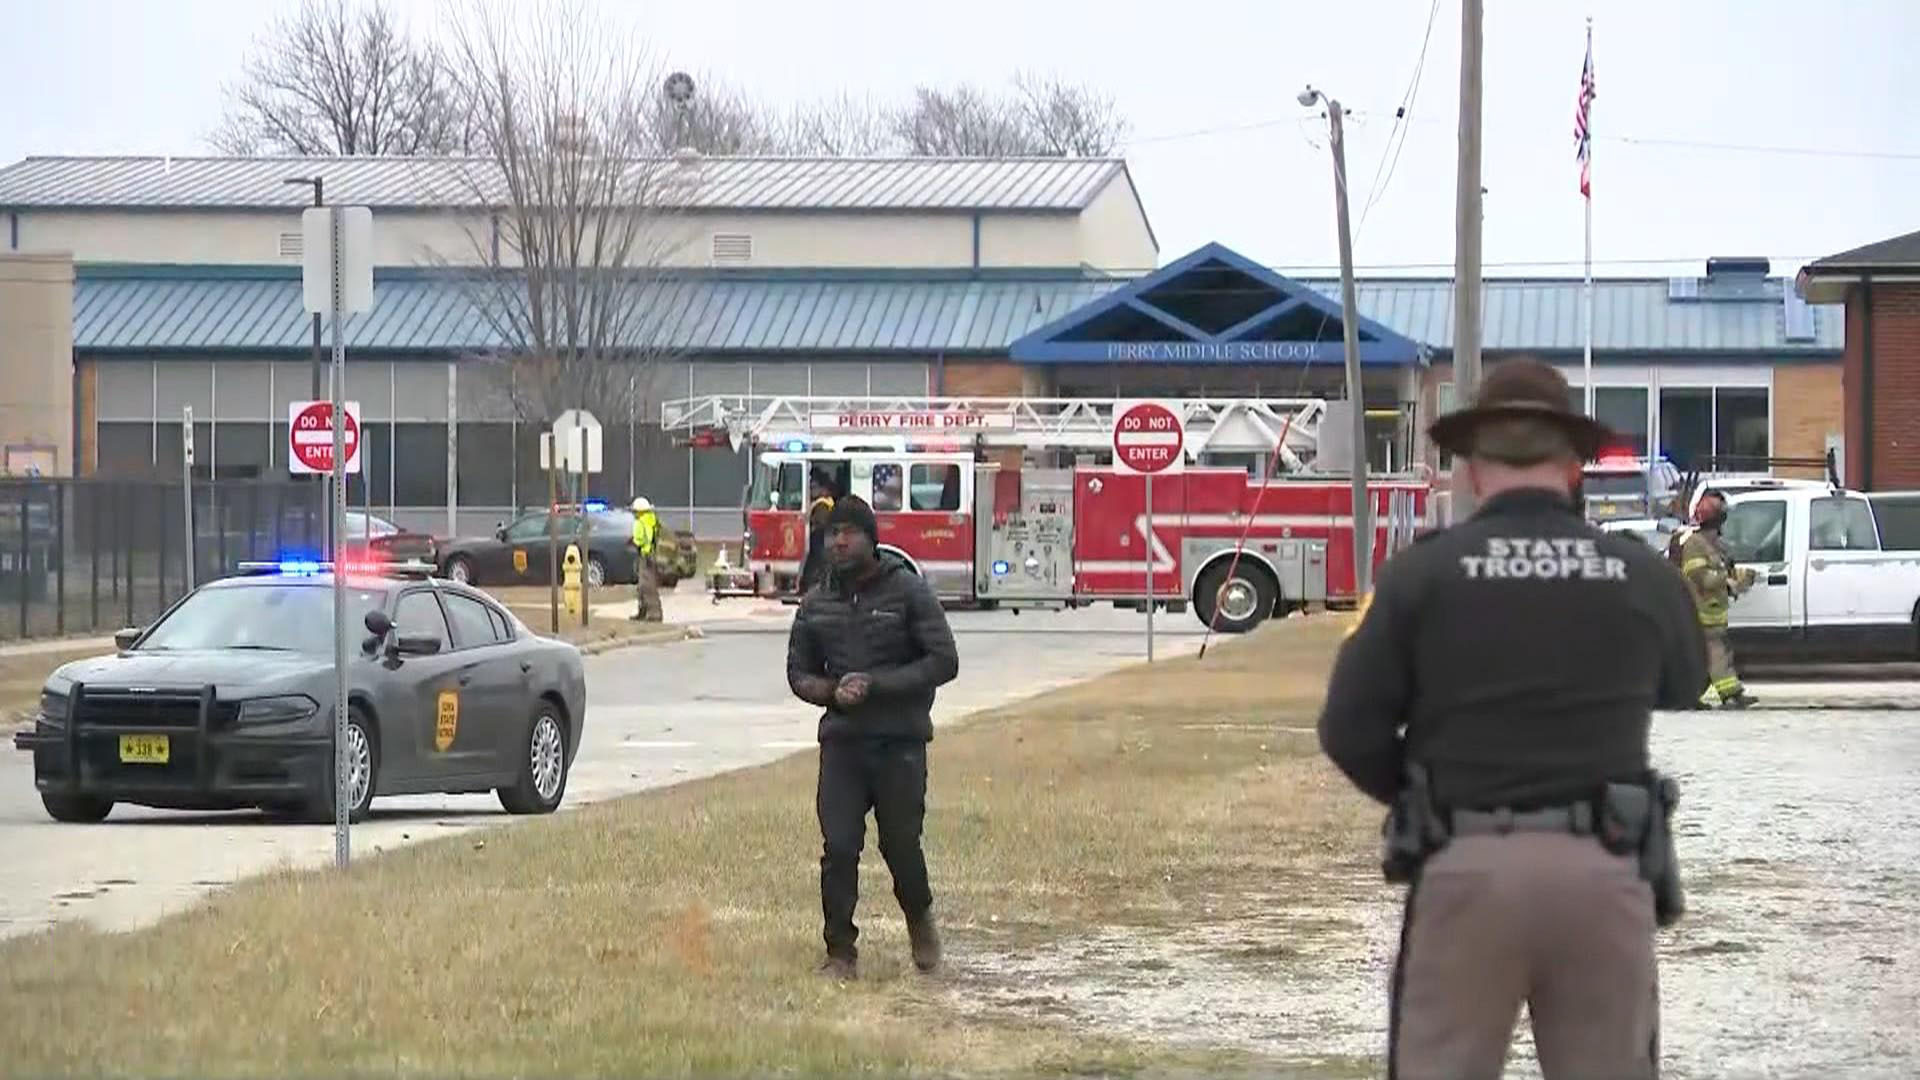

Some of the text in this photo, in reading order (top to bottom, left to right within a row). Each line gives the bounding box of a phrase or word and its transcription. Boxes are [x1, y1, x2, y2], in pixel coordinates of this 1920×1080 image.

[1107, 343, 1320, 360] PERRY MIDDLE SCHOOL
[300, 415, 349, 428] DO NT
[838, 415, 990, 427] PERRY FIRE DEPT.
[1124, 417, 1172, 430] DO NOT
[305, 446, 342, 458] ENTE
[1128, 447, 1168, 460] ENTER
[1487, 537, 1597, 557] STATE
[1460, 556, 1628, 580] TROOPER
